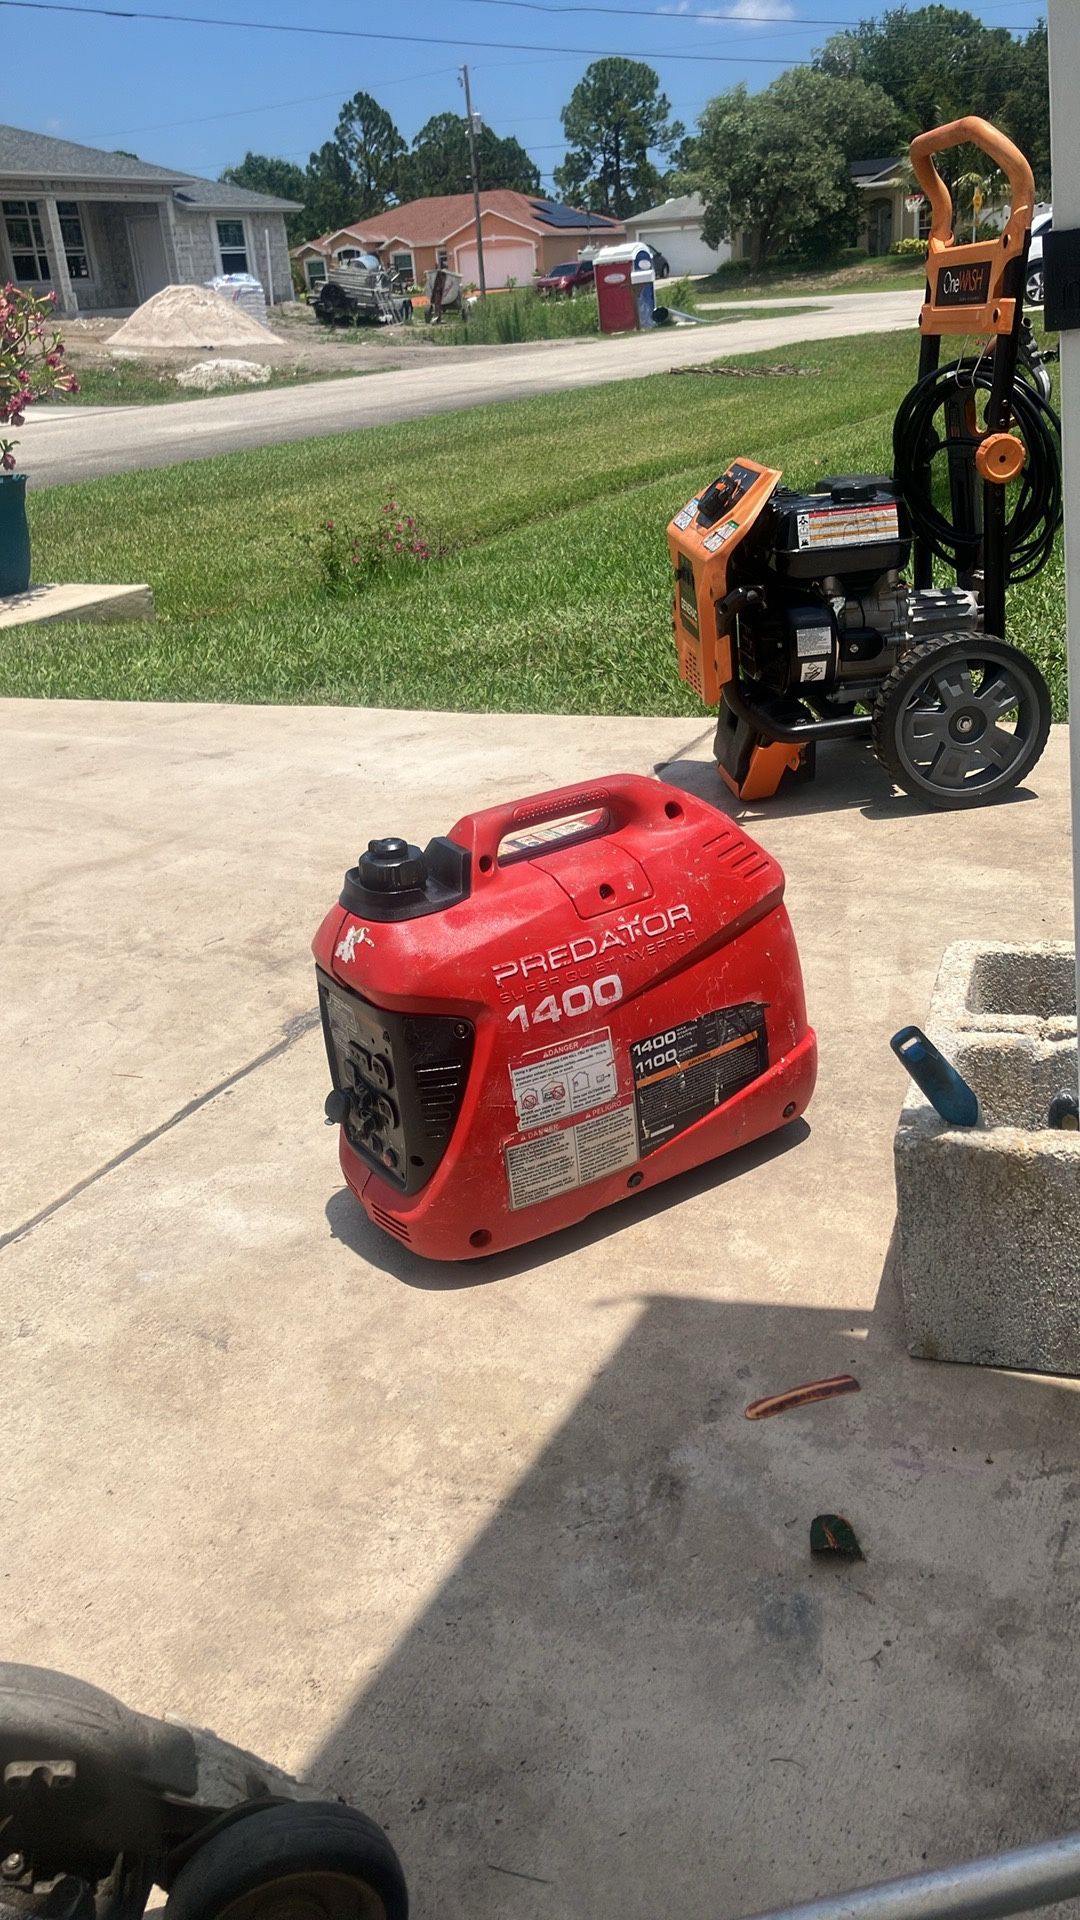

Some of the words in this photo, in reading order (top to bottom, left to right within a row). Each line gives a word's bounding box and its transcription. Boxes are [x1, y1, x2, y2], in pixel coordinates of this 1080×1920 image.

[492, 903, 692, 988] PREDATOR
[499, 975, 560, 1004] SUPER
[565, 955, 616, 982] QUIET
[619, 928, 698, 963] INVERTER
[507, 974, 624, 1033] 1400
[548, 1041, 579, 1056] DANGER
[632, 1030, 677, 1056] 1400
[635, 1048, 678, 1073] 1100
[592, 1100, 622, 1116] PELIGRO
